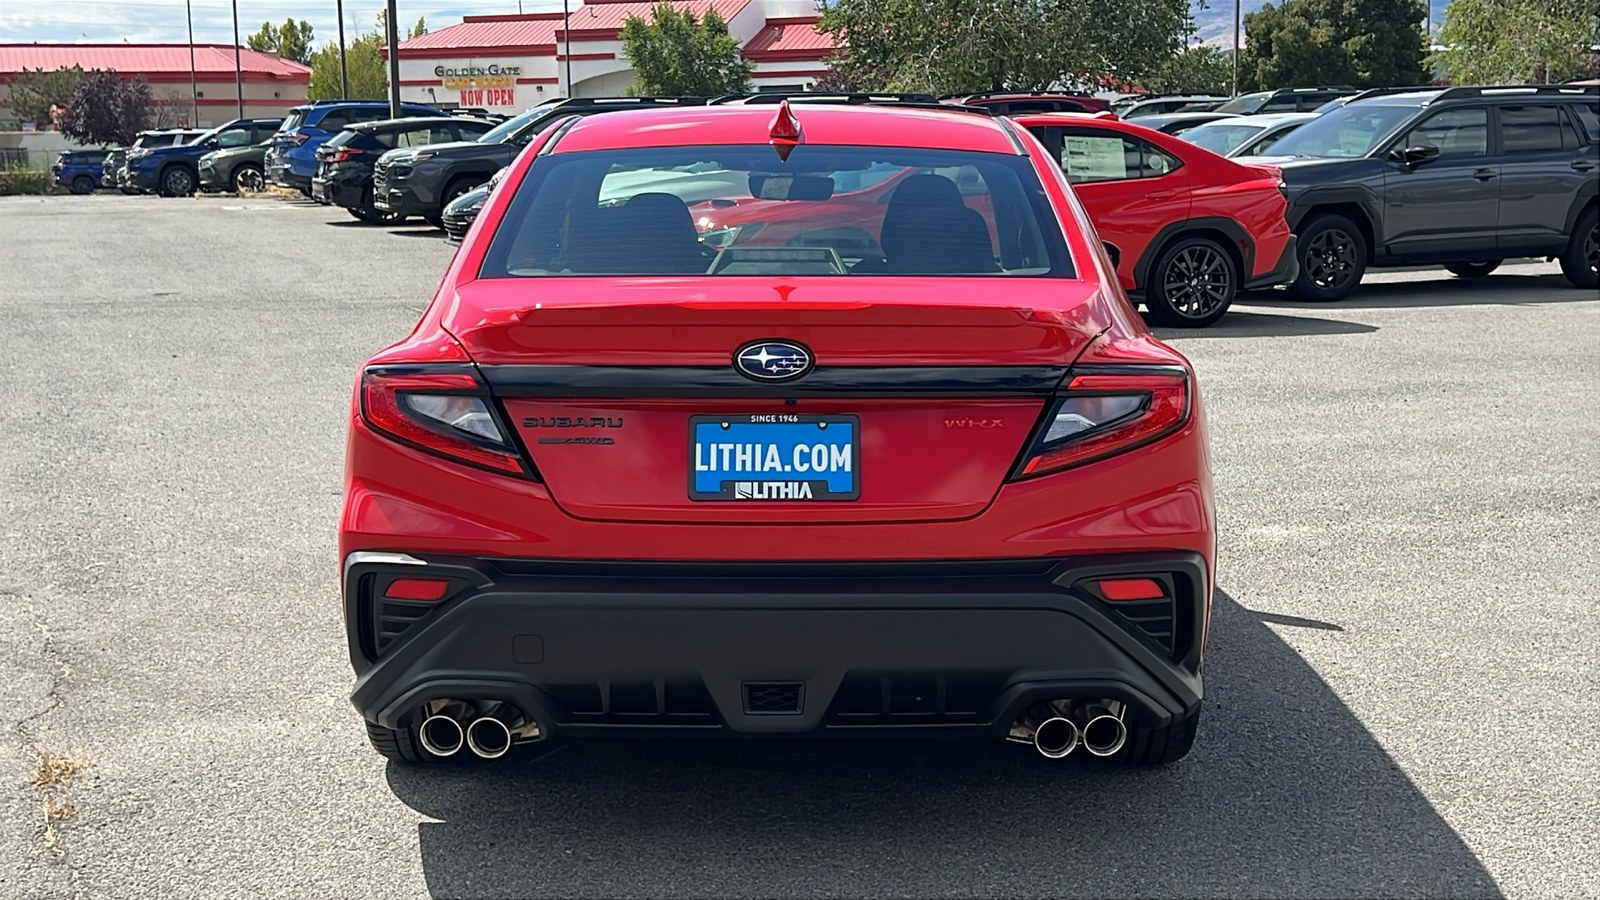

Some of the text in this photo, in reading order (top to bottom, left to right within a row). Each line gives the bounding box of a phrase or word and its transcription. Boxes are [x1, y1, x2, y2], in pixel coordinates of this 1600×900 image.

[434, 64, 520, 77] GOLDEN GATE
[460, 89, 514, 106] NOW OPEN
[522, 416, 623, 428] SUBARU
[944, 418, 1004, 429] WRX
[695, 443, 851, 472] LITHIA.COM
[752, 481, 813, 499] LITHIA
